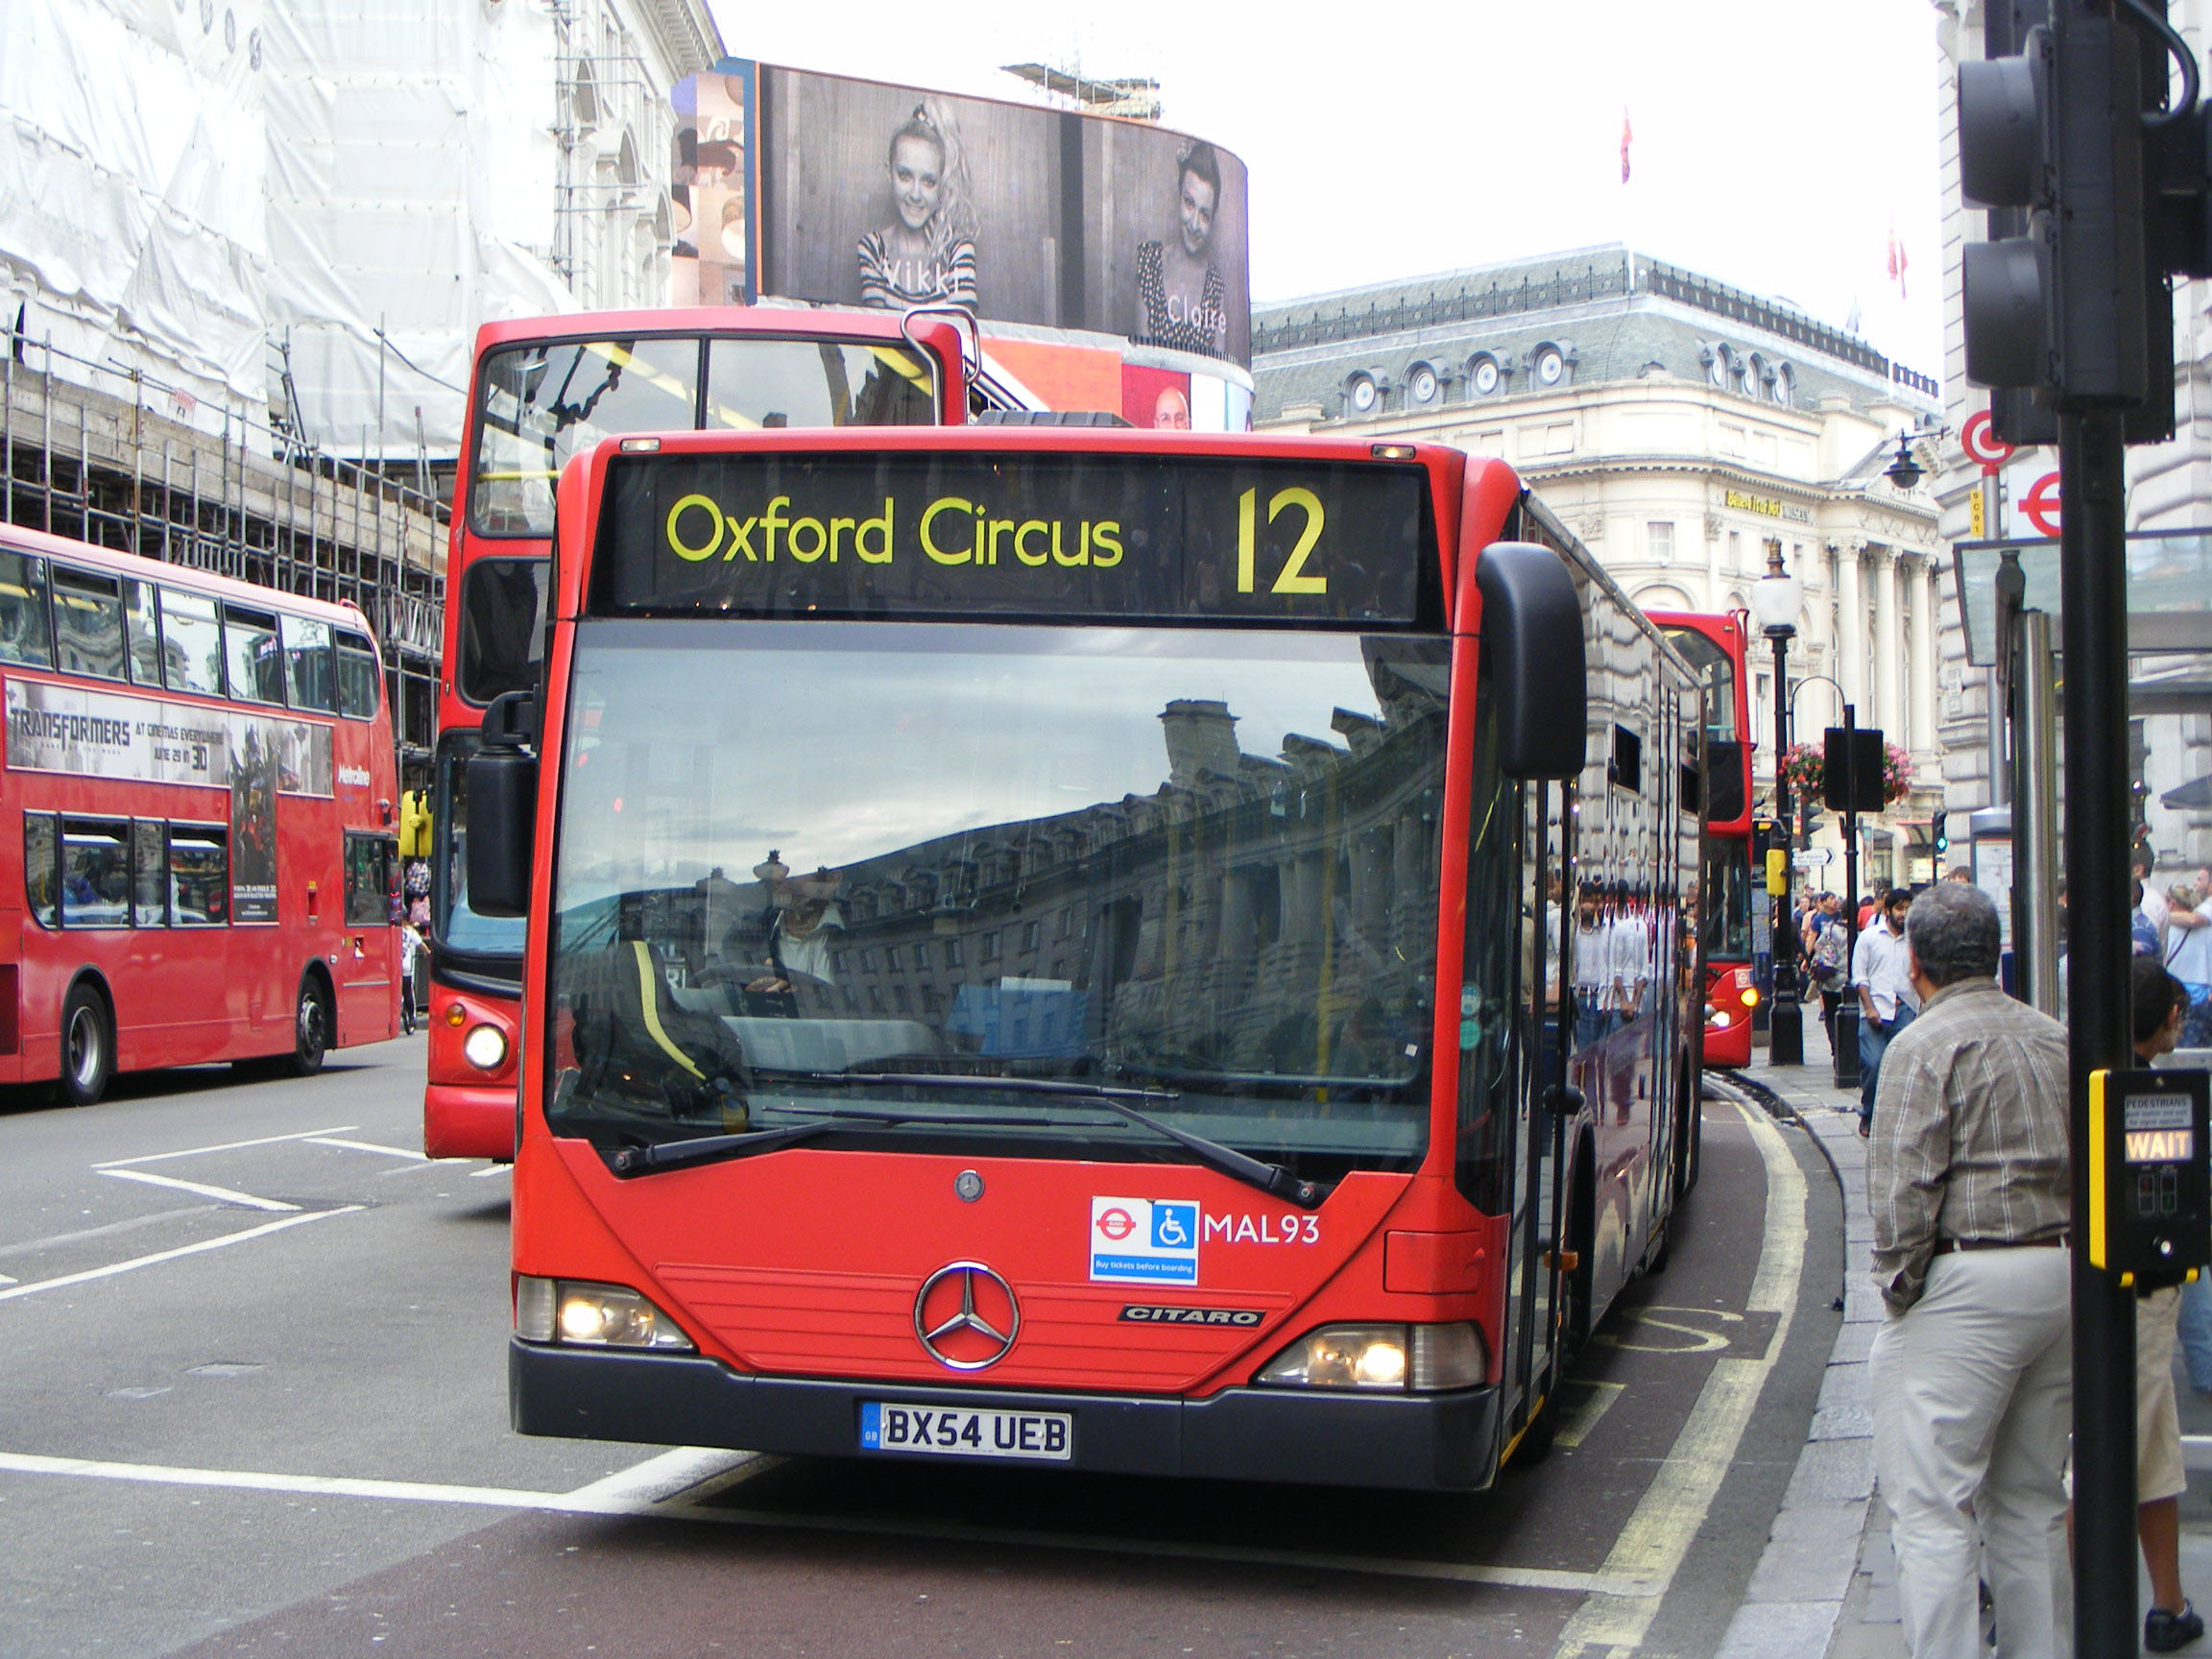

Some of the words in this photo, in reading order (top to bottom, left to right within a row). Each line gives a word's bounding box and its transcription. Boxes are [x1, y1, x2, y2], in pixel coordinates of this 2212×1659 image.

[882, 258, 959, 296] Vikki
[1167, 294, 1227, 334] Claire
[665, 493, 894, 565] Oxford
[919, 495, 1124, 567] Circus
[1237, 486, 1329, 595] 12
[11, 709, 131, 751] TRANSFORMERS
[147, 723, 179, 740] CINEMAS
[192, 745, 207, 771] 3D
[2127, 1097, 2187, 1109] PEDESTRIANS
[2126, 1131, 2189, 1160] WAIT
[1204, 1214, 1320, 1244] MAL93
[1095, 1259, 1110, 1270] Buy
[1111, 1261, 1135, 1270] tickets
[1136, 1262, 1161, 1271] before
[1161, 1263, 1193, 1275] boarding
[1125, 1307, 1259, 1326] CITARO
[887, 1409, 982, 1449] BX54
[994, 1415, 1067, 1453] UEB
